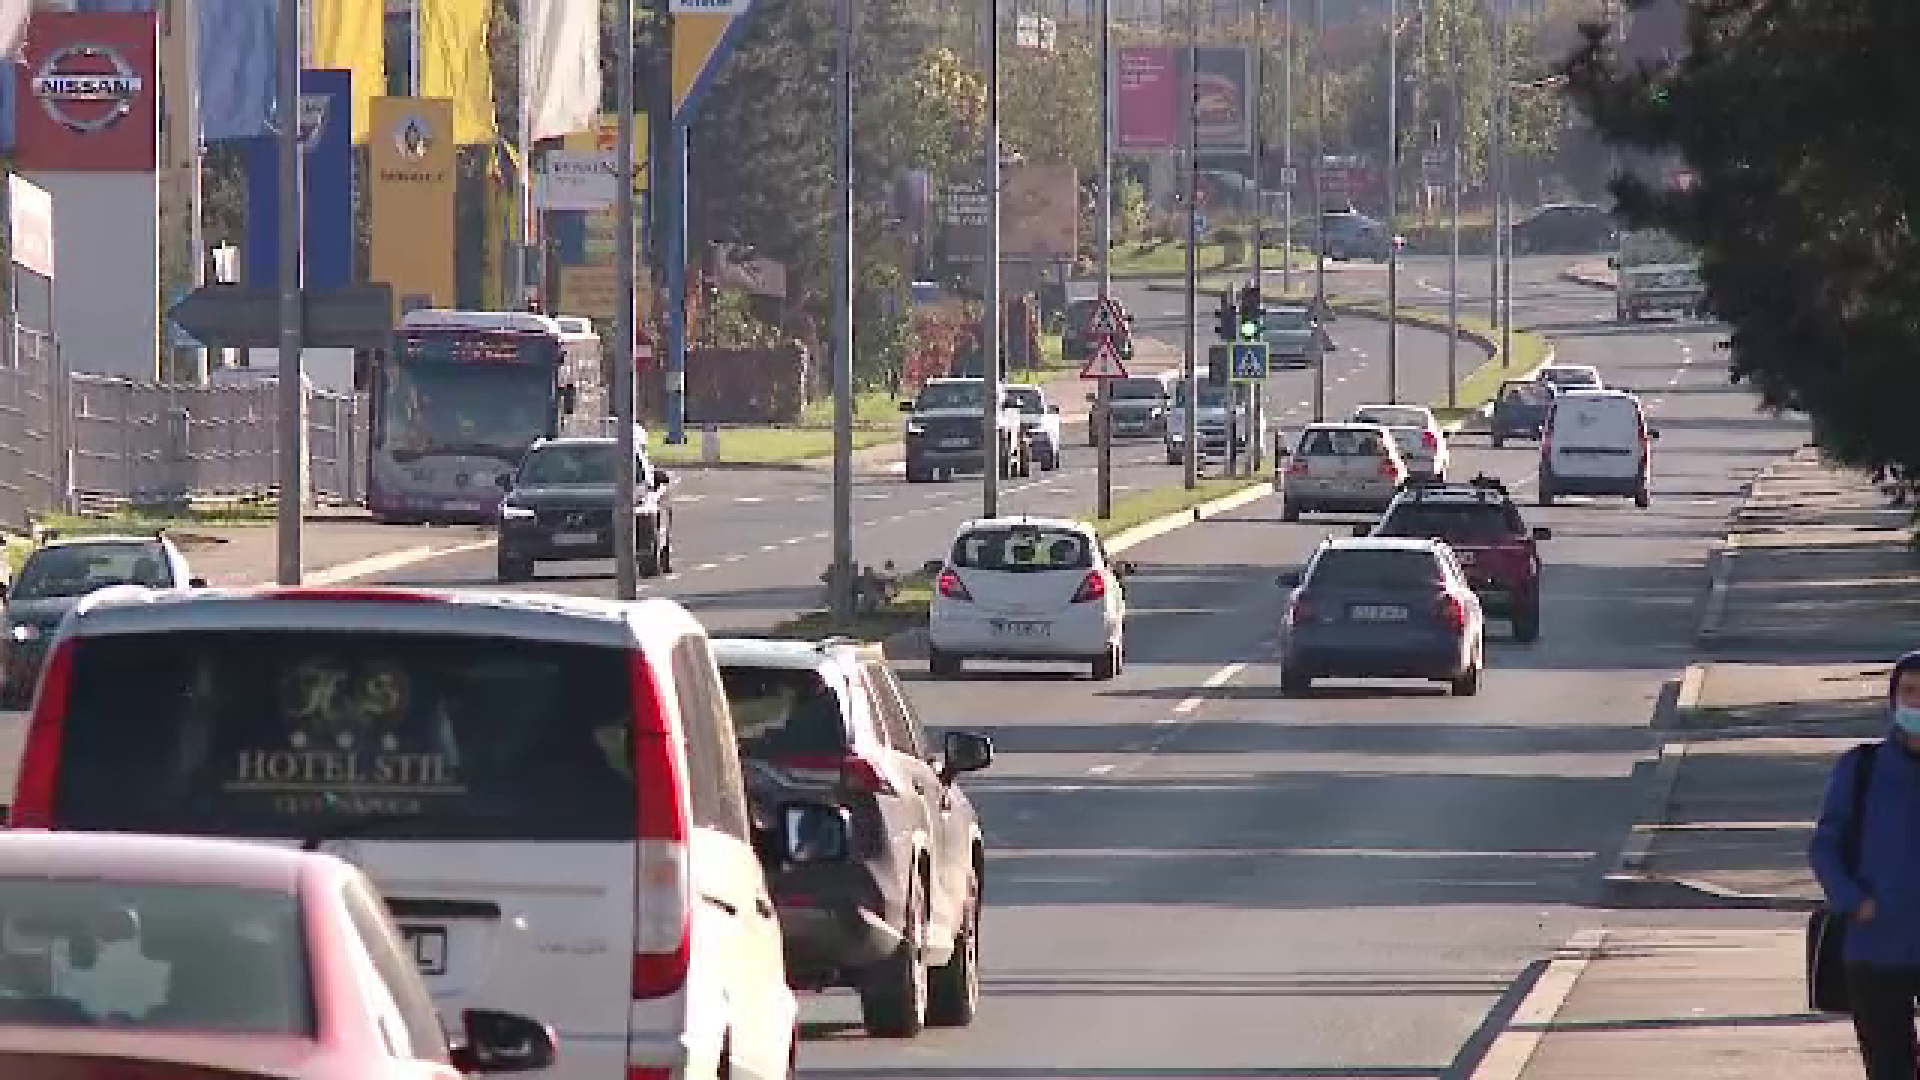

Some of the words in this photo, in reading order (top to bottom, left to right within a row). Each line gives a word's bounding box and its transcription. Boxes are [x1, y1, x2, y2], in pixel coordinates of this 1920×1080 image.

[41, 79, 130, 94] NISSAN
[239, 751, 367, 782] HOTEL
[374, 752, 452, 785] STIL
